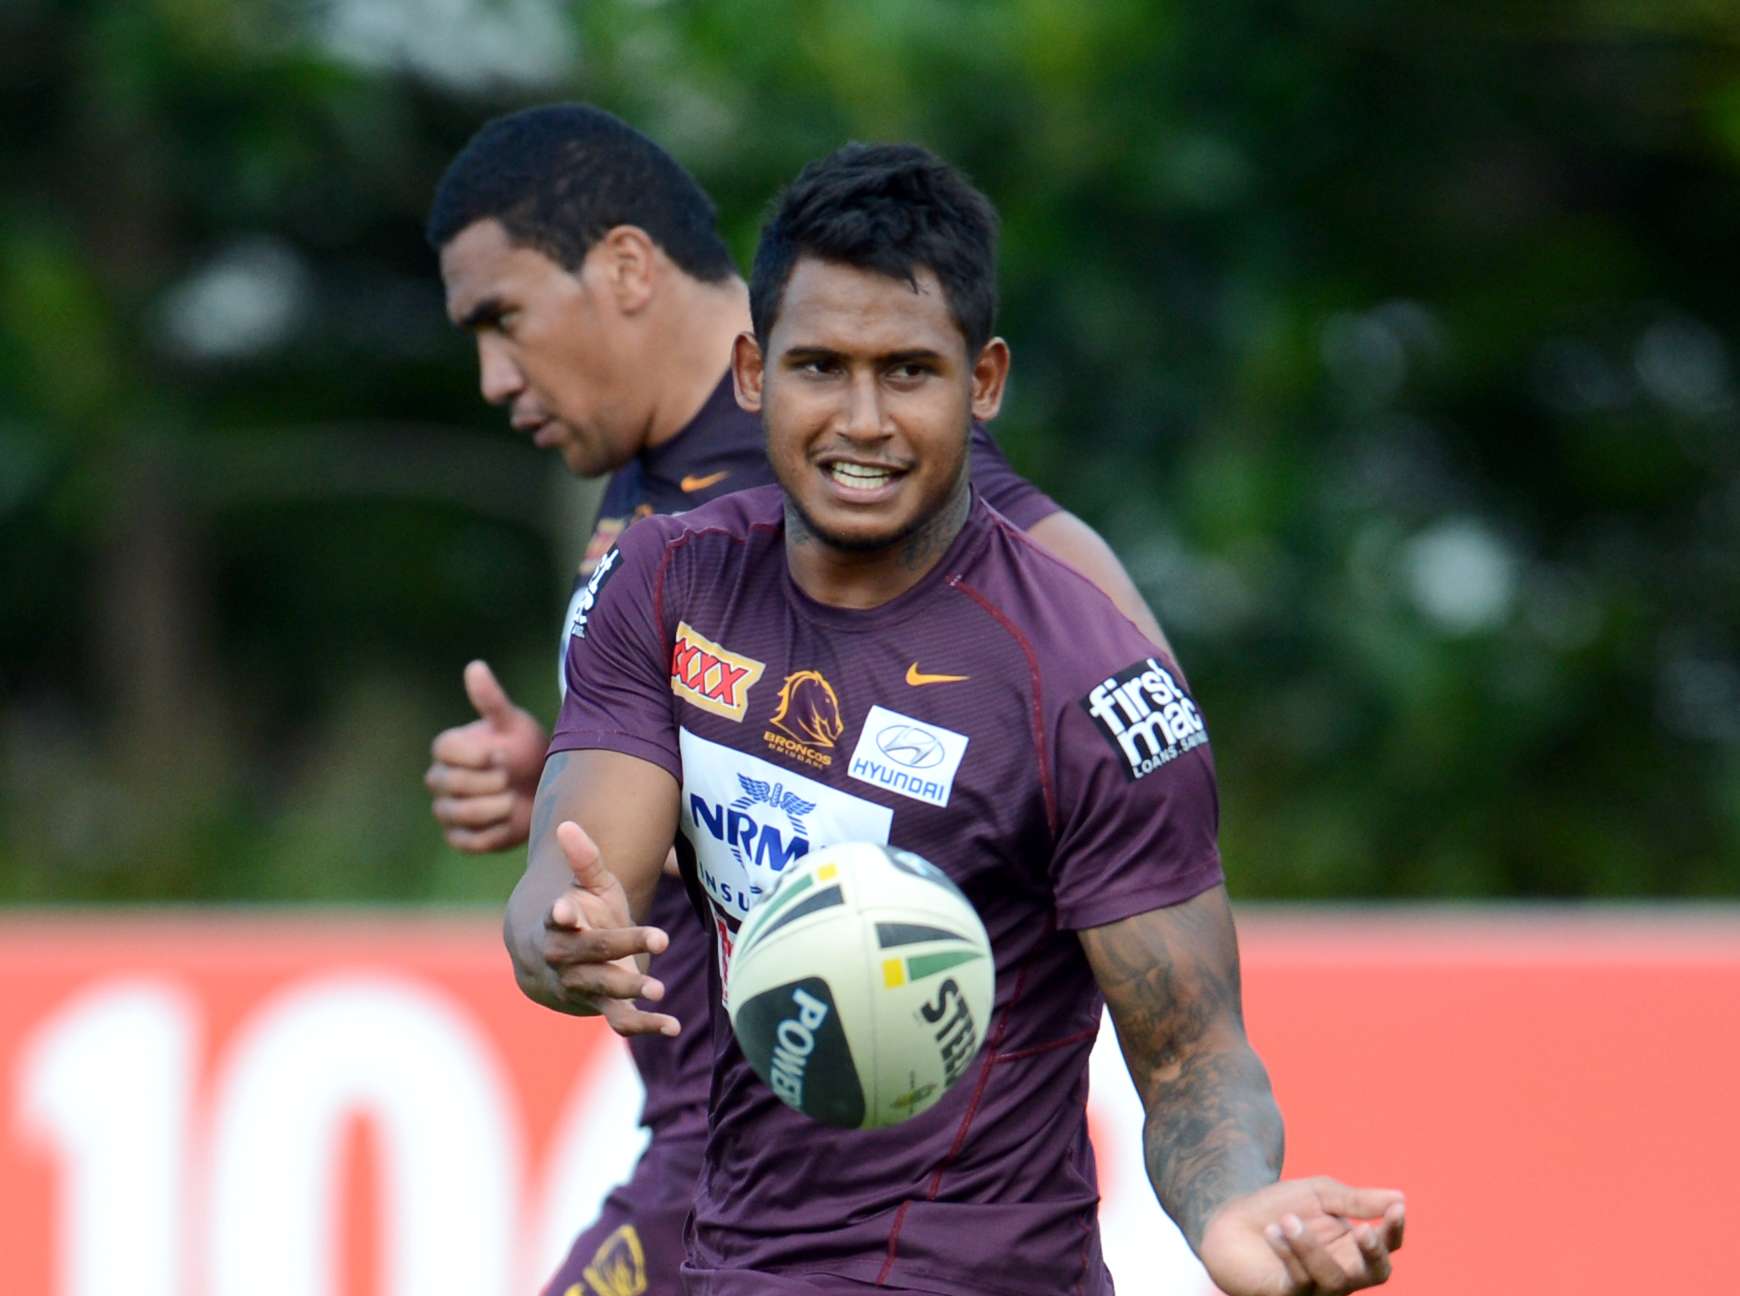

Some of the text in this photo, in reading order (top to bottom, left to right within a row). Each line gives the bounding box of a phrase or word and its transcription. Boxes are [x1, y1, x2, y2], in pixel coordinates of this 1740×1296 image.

[763, 731, 832, 766] BRONCOS
[853, 758, 945, 801] HYUNDAI
[689, 792, 812, 872] NRM
